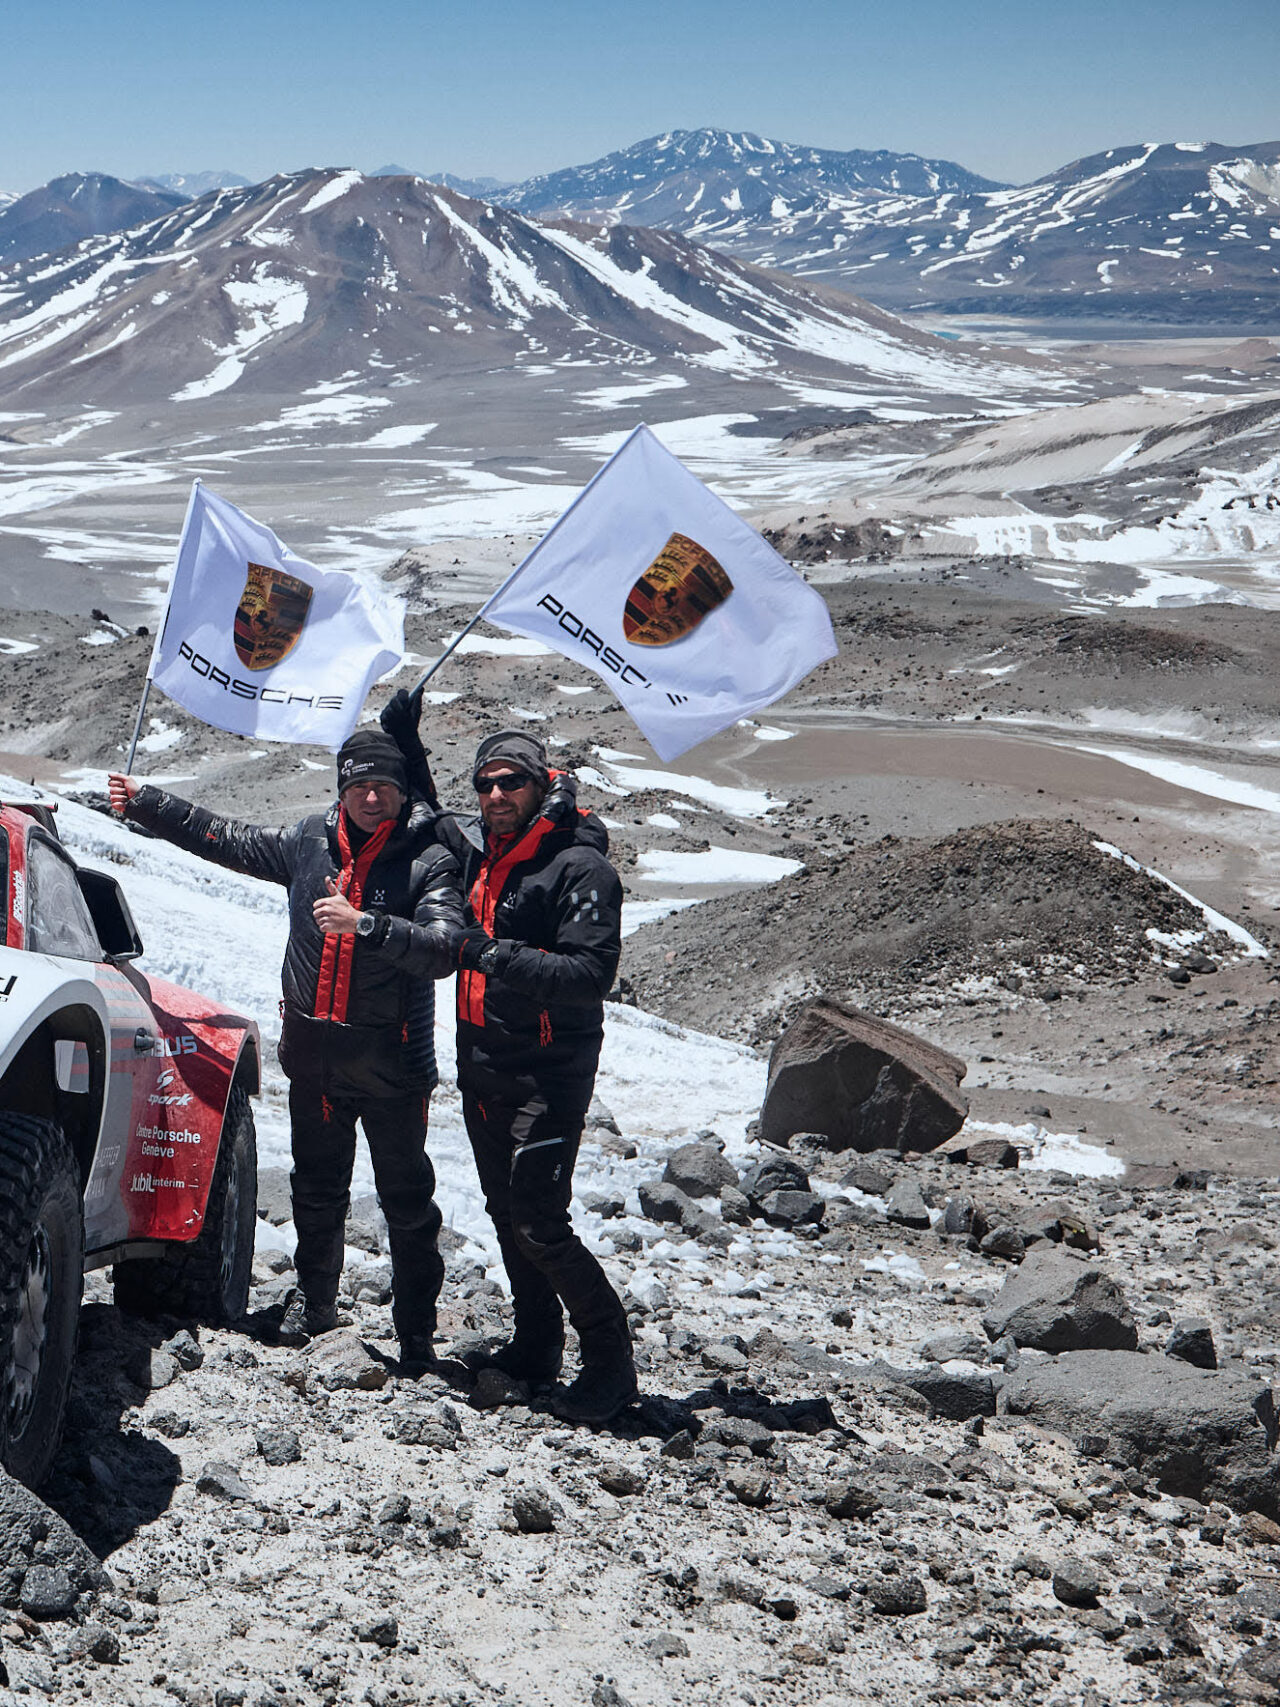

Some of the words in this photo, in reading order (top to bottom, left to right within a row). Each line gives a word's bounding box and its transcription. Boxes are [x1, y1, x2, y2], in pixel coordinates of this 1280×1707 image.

[178, 641, 344, 709] PORSCHE
[153, 1125, 201, 1144] Porsche
[141, 1141, 175, 1158] Genève
